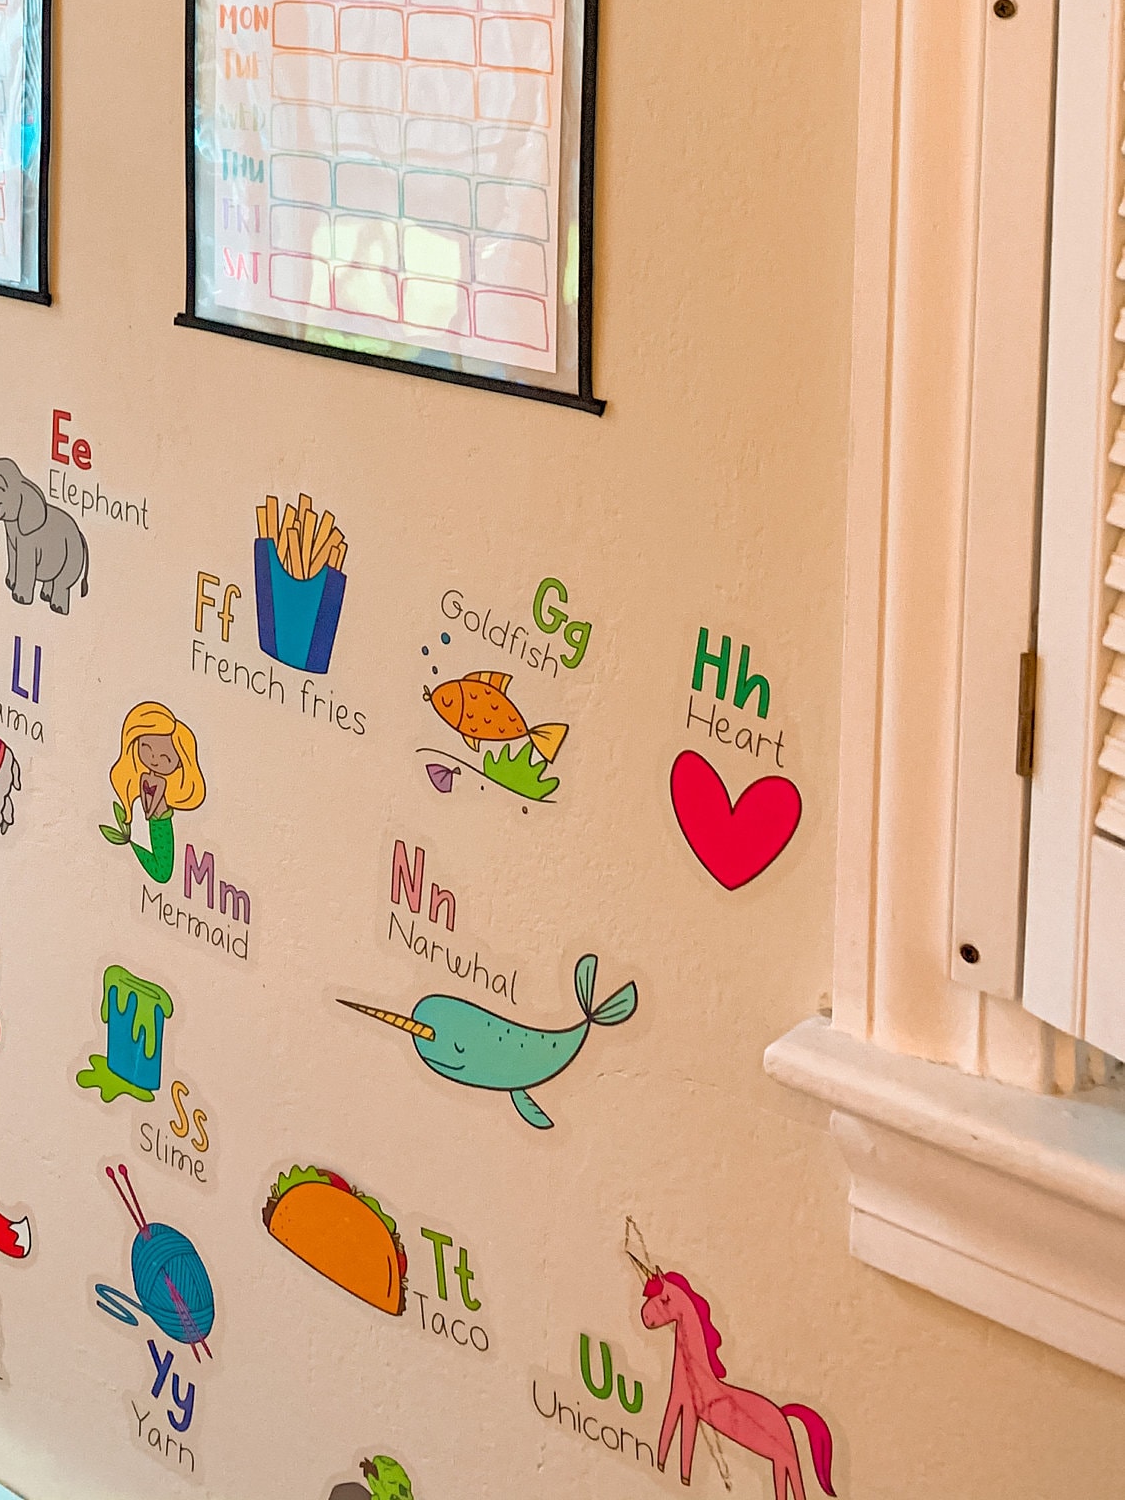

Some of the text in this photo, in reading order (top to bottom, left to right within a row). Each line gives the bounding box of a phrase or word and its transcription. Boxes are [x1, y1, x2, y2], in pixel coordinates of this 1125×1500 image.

[219, 4, 269, 35] MON
[222, 48, 259, 81] TUE
[221, 148, 264, 183] THU
[222, 247, 262, 285] SAT
[51, 408, 92, 470] Ee
[48, 468, 149, 530] Elephant
[195, 571, 241, 642] Ff
[440, 589, 559, 679] Goldfish
[532, 577, 592, 669] Gg
[191, 640, 367, 736] French fries
[692, 626, 772, 719] Hh
[686, 703, 786, 769] Heart
[184, 843, 251, 925] Mm
[390, 839, 456, 932] Nn
[141, 884, 249, 961] Mermaid
[388, 910, 517, 1006] Narwhal
[139, 1122, 207, 1184] Slime
[169, 1080, 210, 1153] Ss
[420, 1226, 482, 1312] Tt
[413, 1290, 490, 1353] Taco
[147, 1339, 195, 1432] Yy
[579, 1332, 644, 1414] Uu
[131, 1399, 196, 1473] Yarn
[532, 1379, 655, 1469] Unicorn
